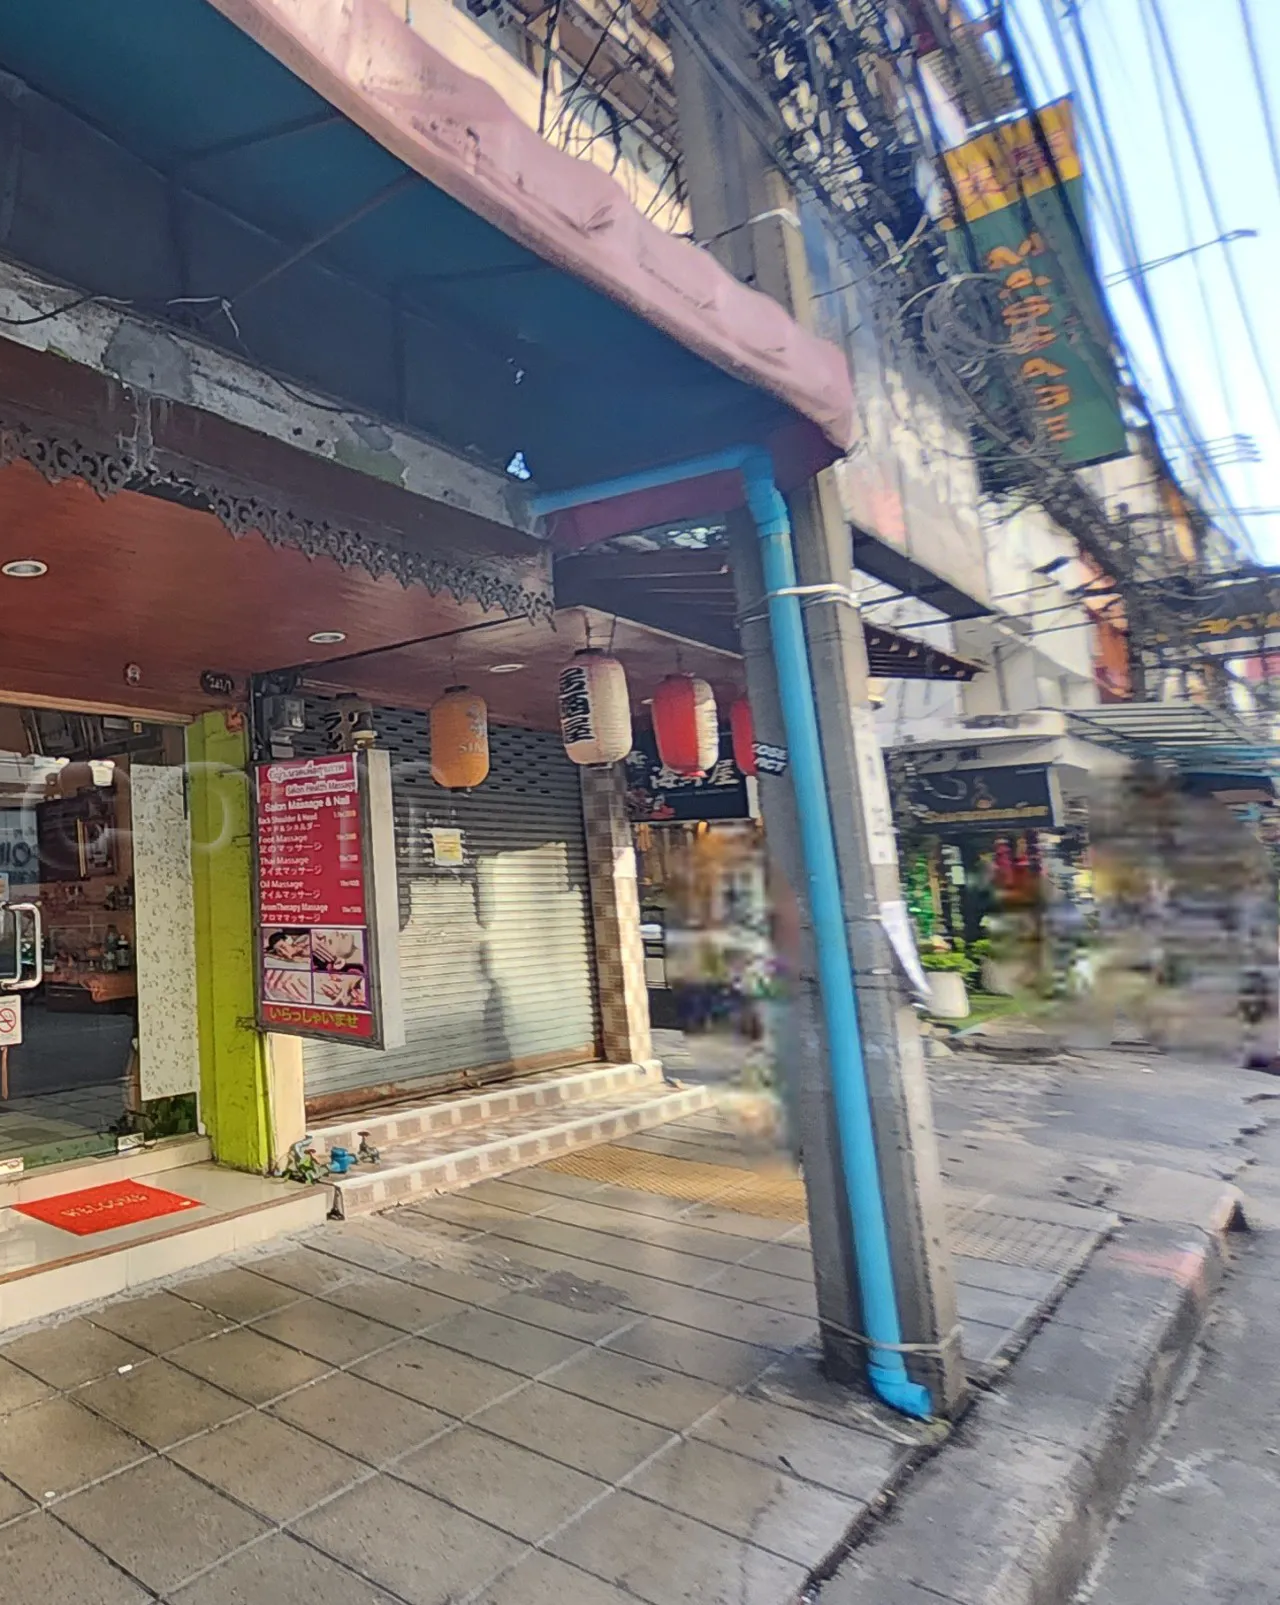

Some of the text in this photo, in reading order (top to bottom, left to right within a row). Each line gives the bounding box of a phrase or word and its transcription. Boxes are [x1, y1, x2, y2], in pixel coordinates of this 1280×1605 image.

[329, 781, 356, 792] Massage
[288, 799, 323, 811] Massage
[258, 835, 308, 845] Foot Massage
[260, 856, 309, 867] Thai Massage
[260, 881, 304, 890] Oil Massage
[302, 904, 328, 914] Massage
[269, 1006, 359, 1029] いらっしゃいませ
